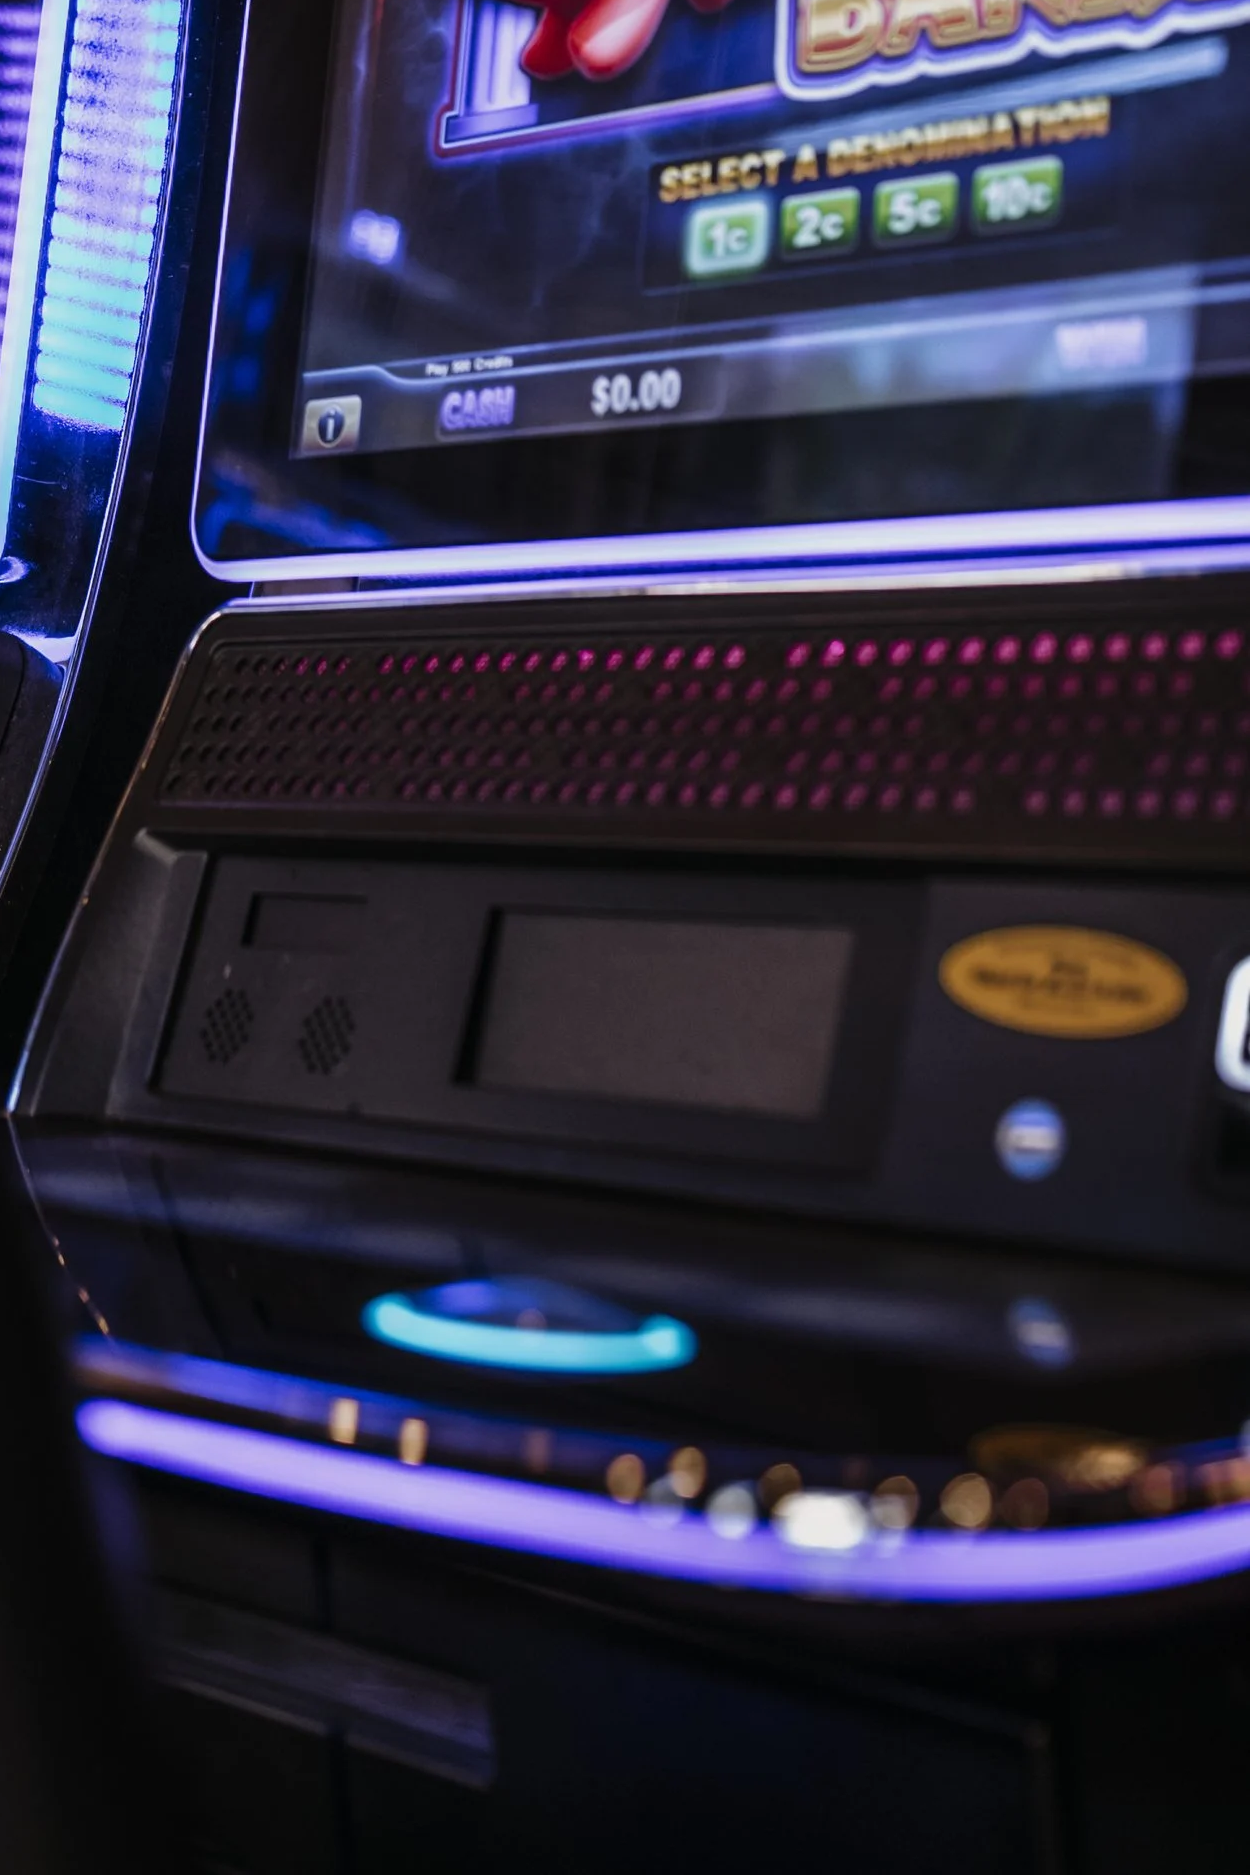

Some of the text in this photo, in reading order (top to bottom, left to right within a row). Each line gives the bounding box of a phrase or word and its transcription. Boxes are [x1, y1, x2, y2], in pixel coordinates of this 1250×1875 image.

[659, 96, 1111, 202] SELECT A DENOMINATION
[590, 367, 682, 418] $0.00
